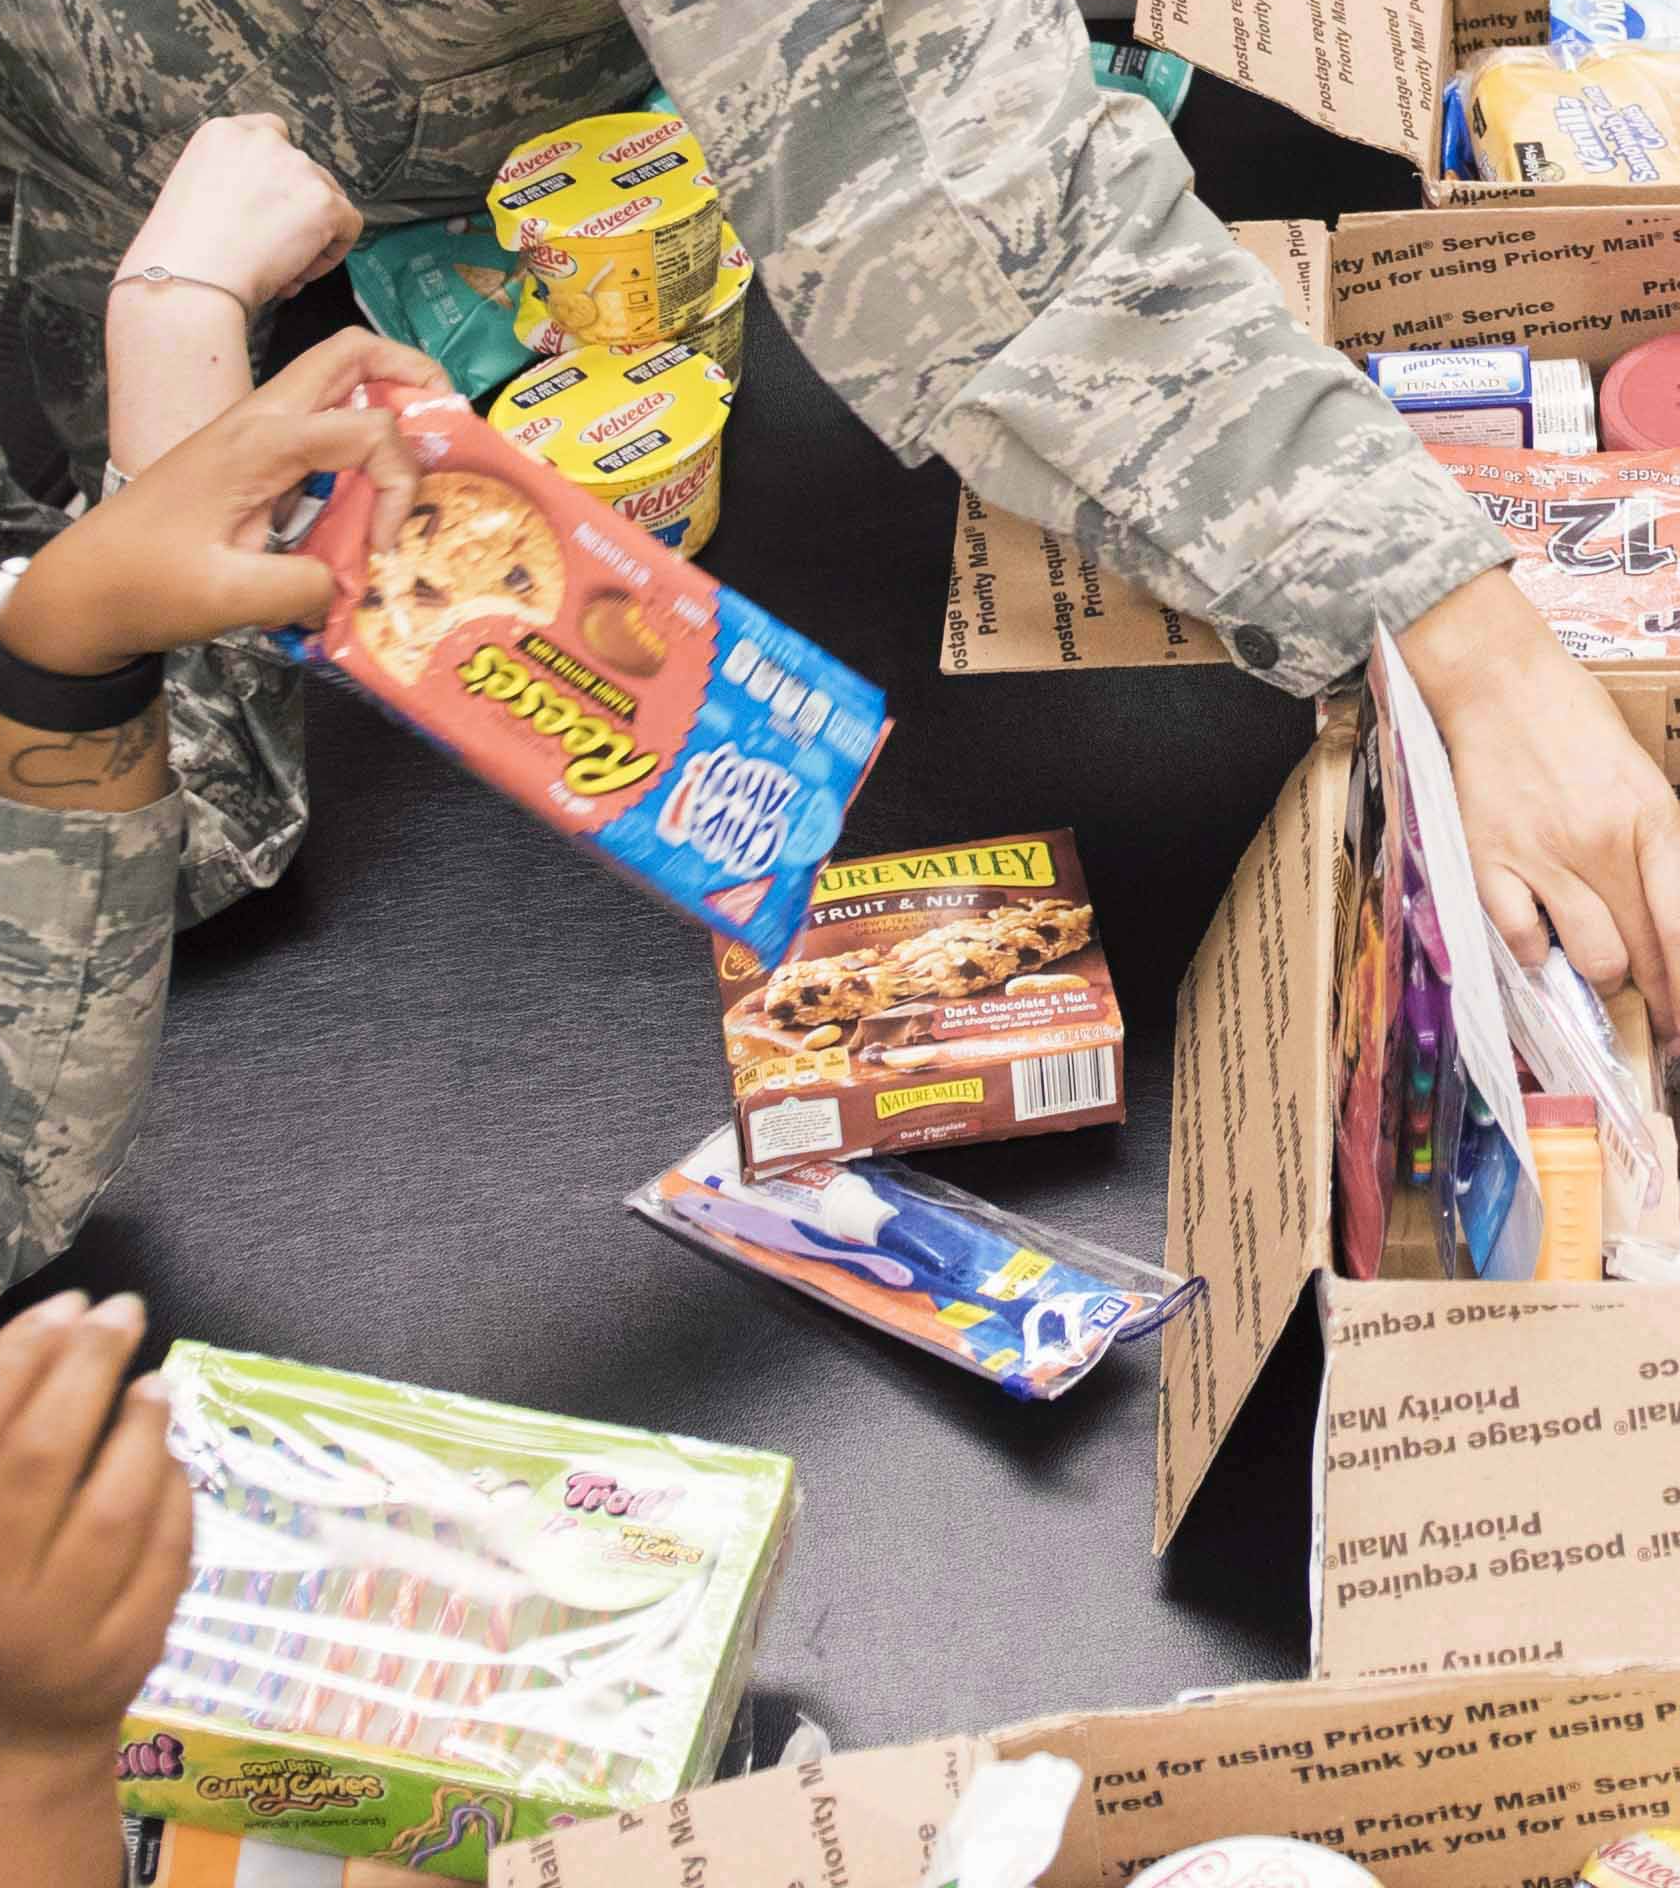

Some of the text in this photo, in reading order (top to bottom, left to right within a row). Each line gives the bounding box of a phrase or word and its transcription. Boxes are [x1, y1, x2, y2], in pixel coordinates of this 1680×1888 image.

[496, 141, 572, 184] Velveeta
[607, 120, 684, 163] Velveeta
[1337, 280, 1382, 301] you
[1388, 268, 1422, 287] for
[1431, 258, 1497, 281] using
[1505, 242, 1596, 266] Priority
[1603, 232, 1665, 254] Mail®
[1372, 227, 1536, 266] Mail® Service
[1401, 354, 1498, 374] BRUNSWICK
[1405, 376, 1501, 391] TUNA SALAD
[588, 391, 666, 444] Velveeta
[622, 446, 718, 521] Velveeta
[1546, 497, 1677, 575] 12
[457, 642, 661, 797] Reese's
[820, 866, 891, 892] URE
[813, 894, 980, 925] FRUIT & NUT
[944, 991, 1089, 1019] Dark Chocolate & Nut
[880, 1082, 981, 1114] NATURE VALLEY
[1488, 1534, 1626, 1578] postage
[1337, 1561, 1479, 1609] required
[197, 1774, 384, 1802] Curvy Canes
